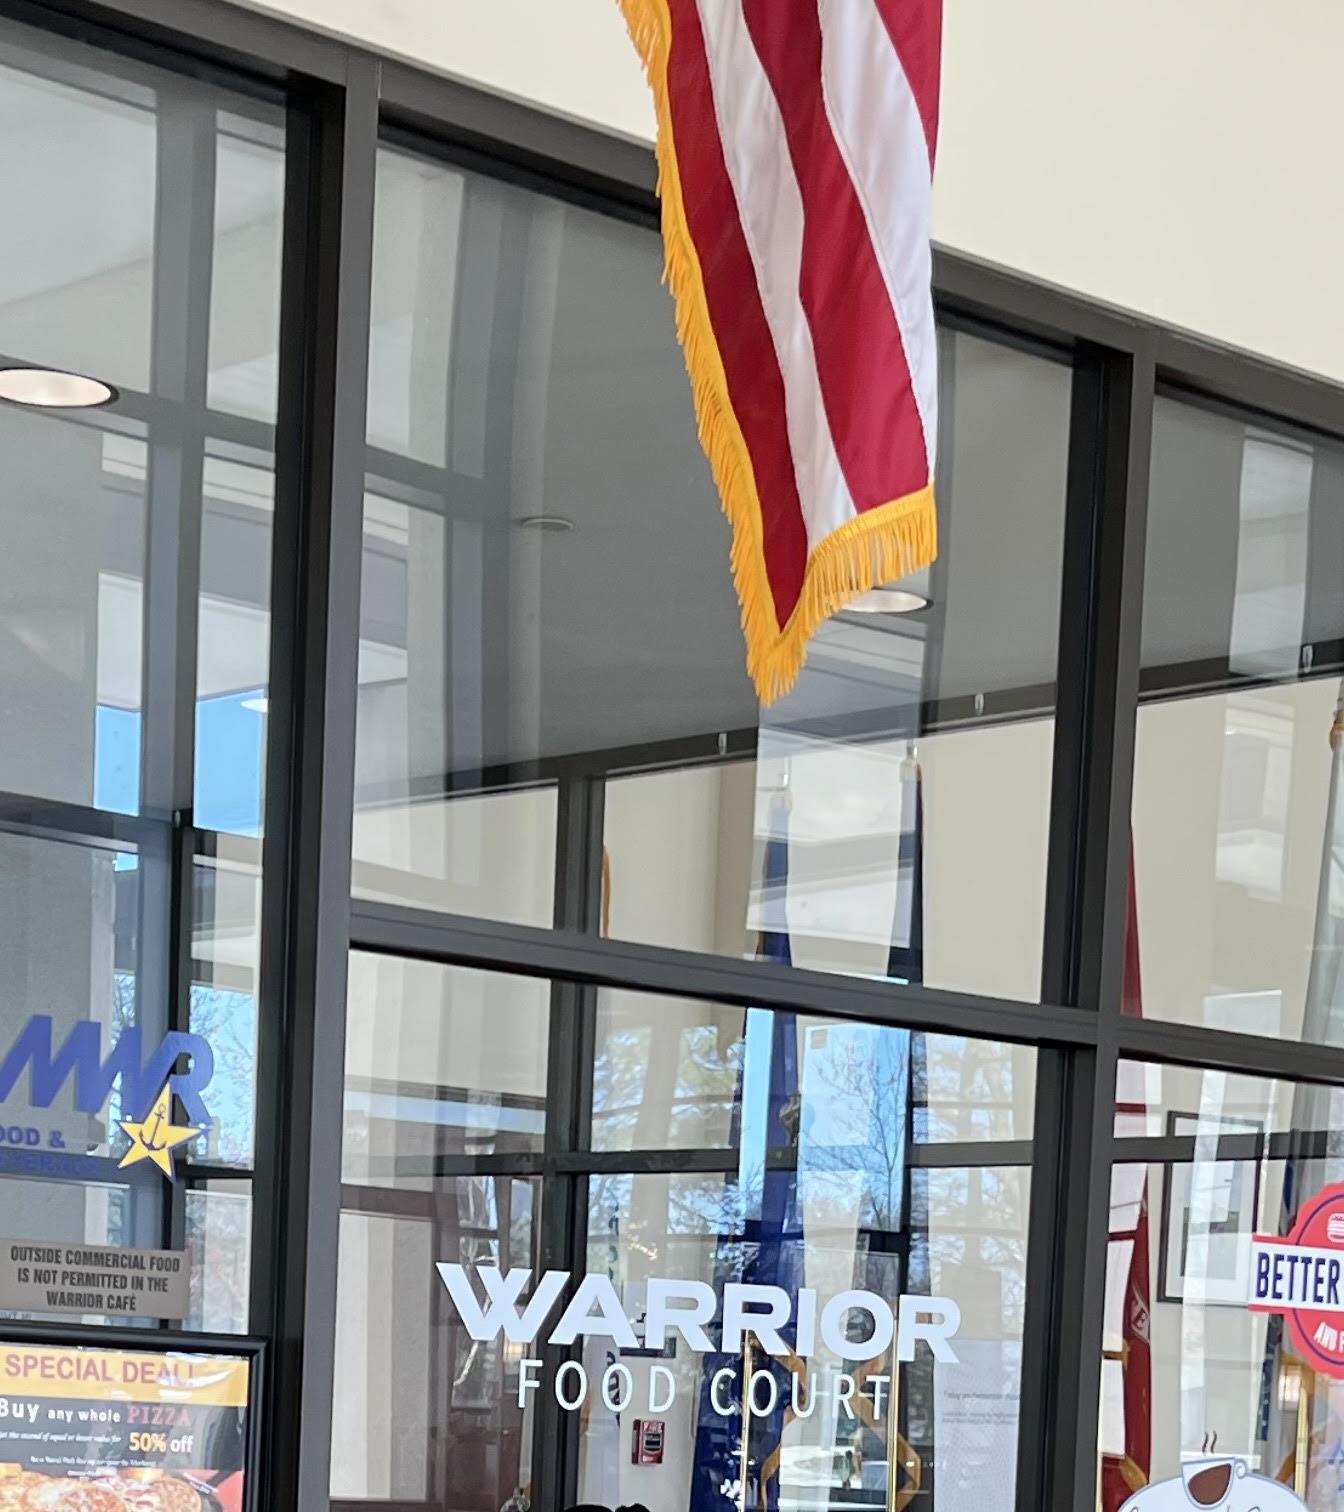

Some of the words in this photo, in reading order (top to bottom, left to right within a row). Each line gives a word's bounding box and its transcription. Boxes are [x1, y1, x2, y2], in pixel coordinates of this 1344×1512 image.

[49, 1130, 65, 1149] &
[10, 1246, 62, 1265] OUTSIDE
[65, 1250, 146, 1270] COMMERCIAL
[149, 1256, 180, 1272] FOOD
[17, 1267, 30, 1283] IS
[33, 1269, 58, 1285] NOT
[61, 1271, 128, 1290] PERMITTED
[131, 1276, 144, 1290] IN
[147, 1277, 168, 1292] THE
[1256, 1251, 1341, 1305] BETTER
[46, 1290, 104, 1309] WARRIOR
[436, 1262, 961, 1363] WARRIOR
[1313, 1321, 1338, 1351] AND
[5, 1353, 114, 1383] SPECIAL
[518, 1358, 676, 1413] FOOD
[711, 1368, 890, 1420] COURT
[48, 1408, 73, 1423] any
[78, 1408, 121, 1423] whole
[127, 1405, 192, 1426] PIZZA
[129, 1432, 167, 1452] 50%
[170, 1435, 194, 1453] off
